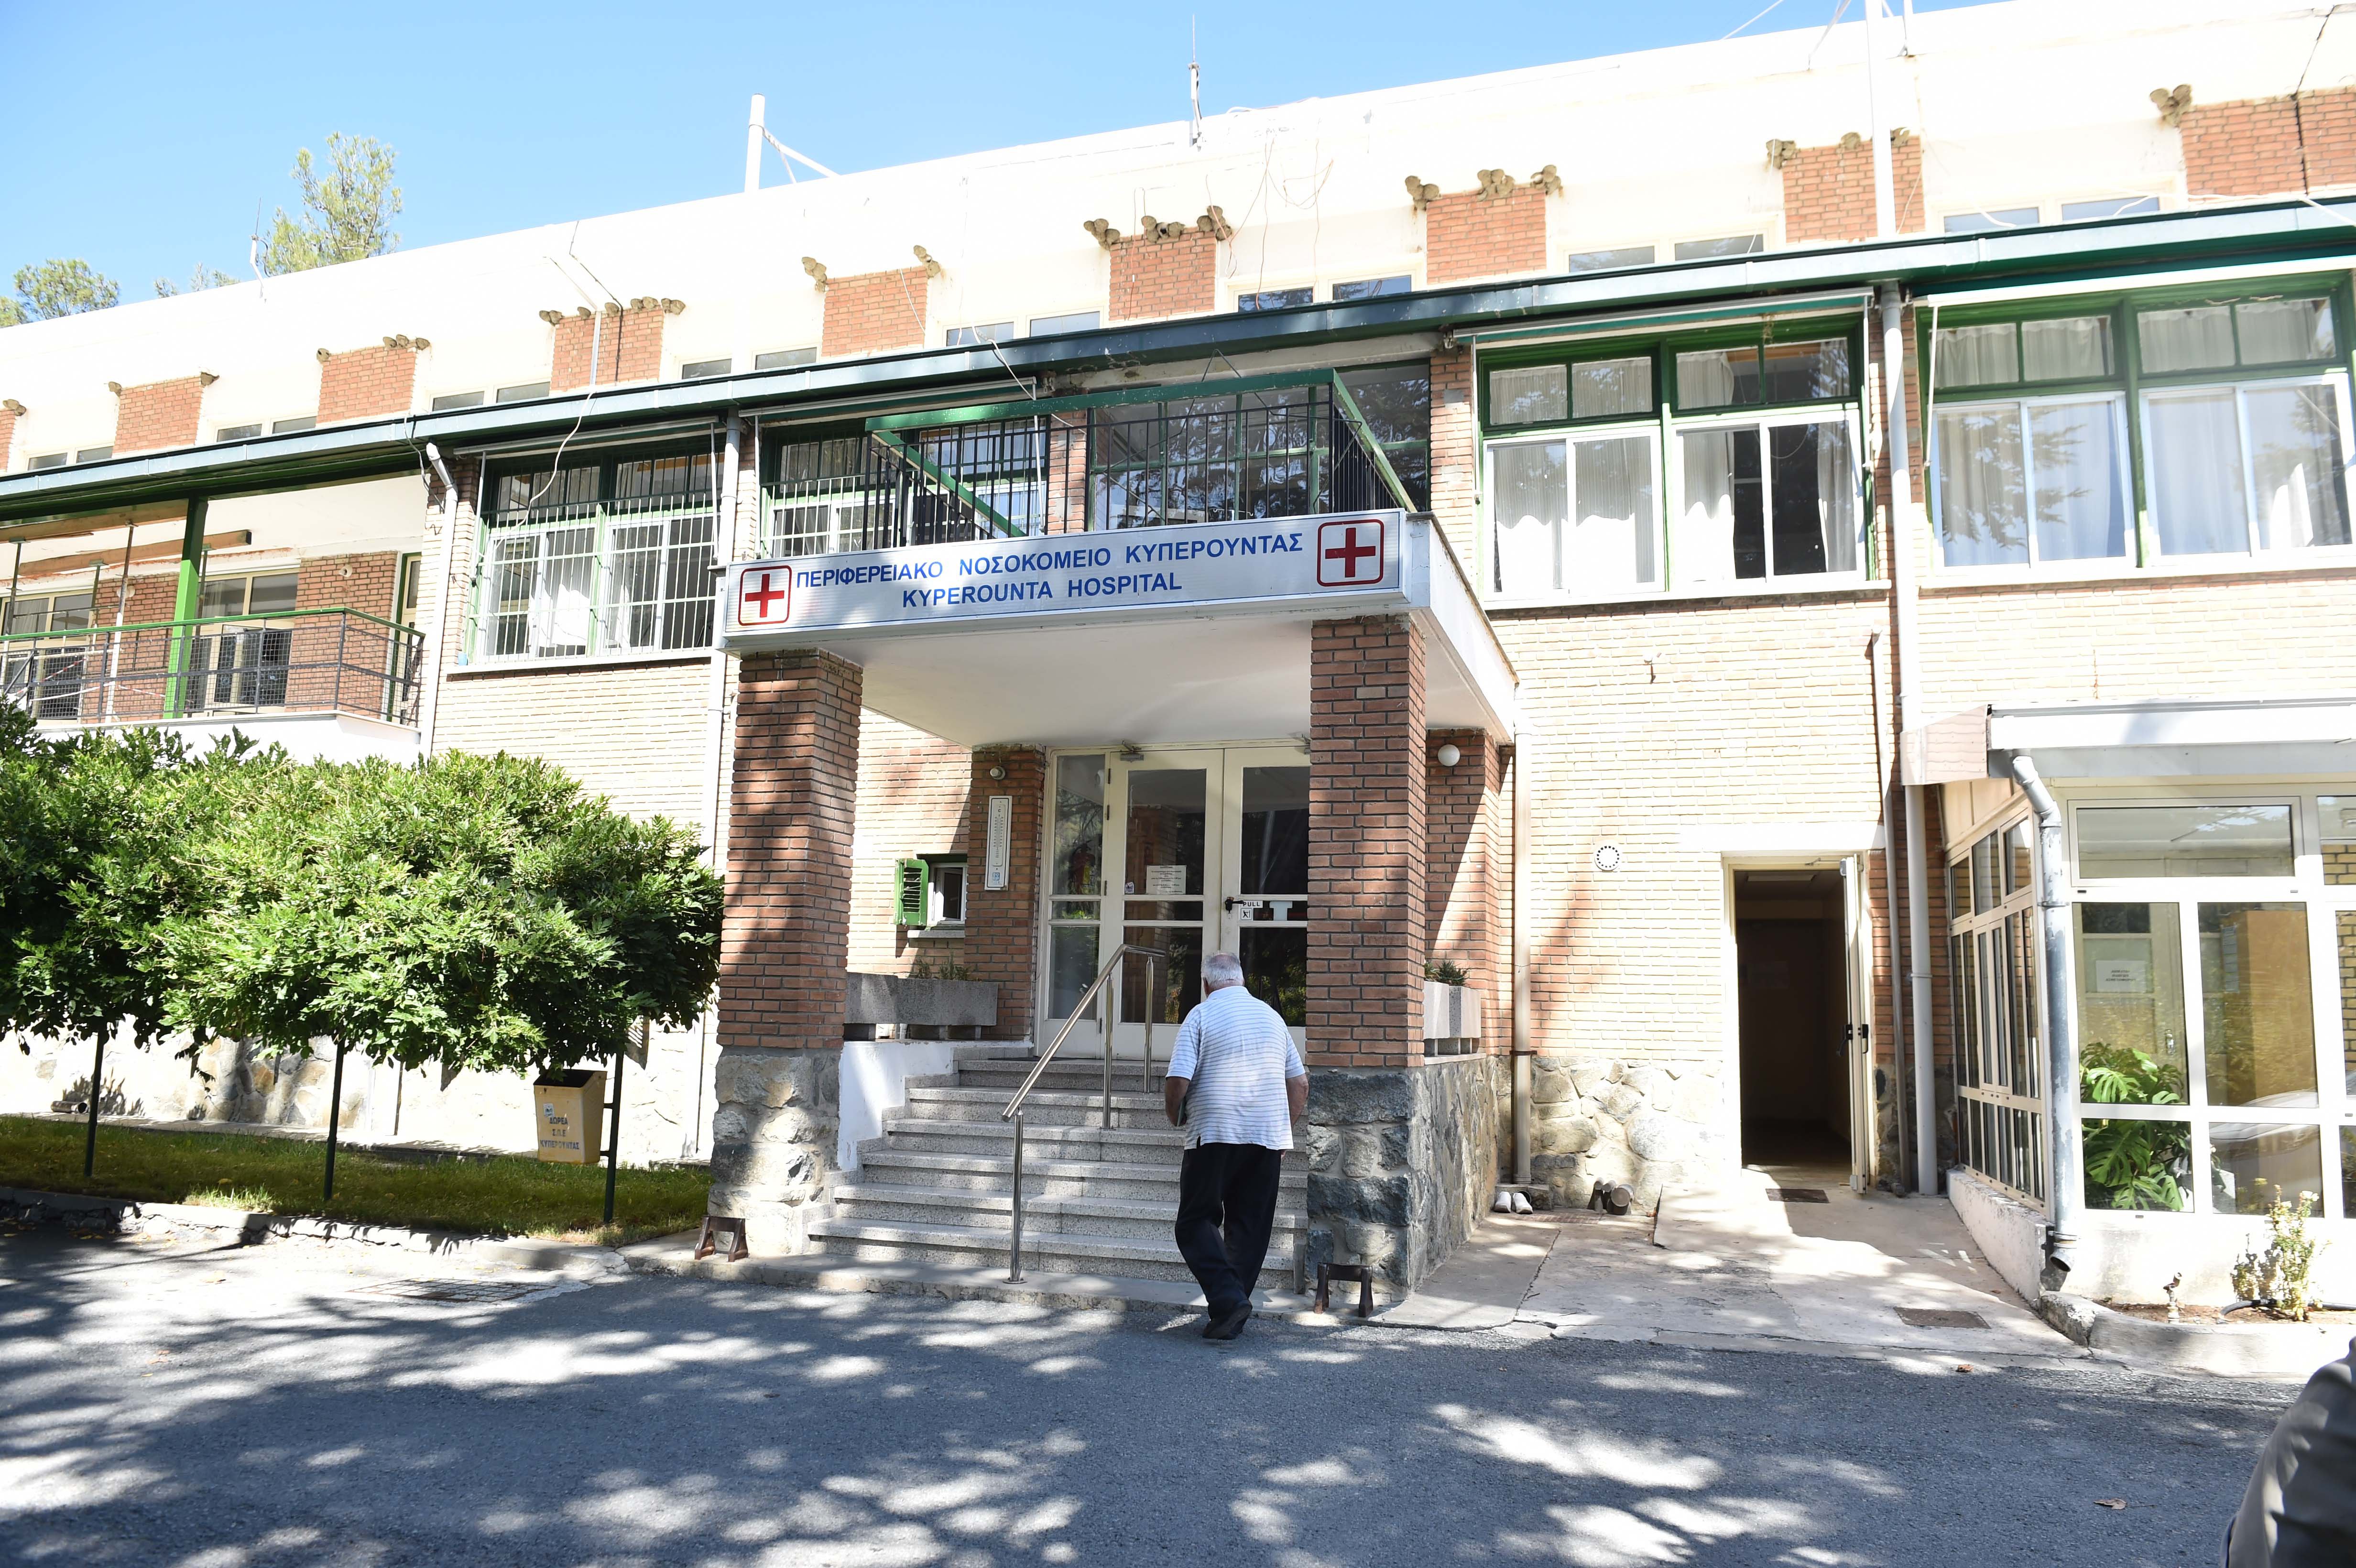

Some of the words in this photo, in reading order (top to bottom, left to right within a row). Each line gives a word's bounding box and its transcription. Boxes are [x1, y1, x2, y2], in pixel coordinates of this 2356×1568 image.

[797, 561, 943, 587] ΠΕΡΙΦΕΡΕΙΑΚΟ
[959, 548, 1111, 575] ΝΟΣΟΚΟΜΕΙΟ
[1126, 533, 1303, 564] ΚΥΠΕΡΟΥΝΤΑΣ
[903, 581, 1053, 608] KYPEROUNTA
[1068, 573, 1182, 597] HOSPITAL
[549, 1117, 568, 1125] ΔΩΡΕΑ
[540, 1140, 579, 1150] ΚΥΠΕΡΟΥΝΤΑΣ
